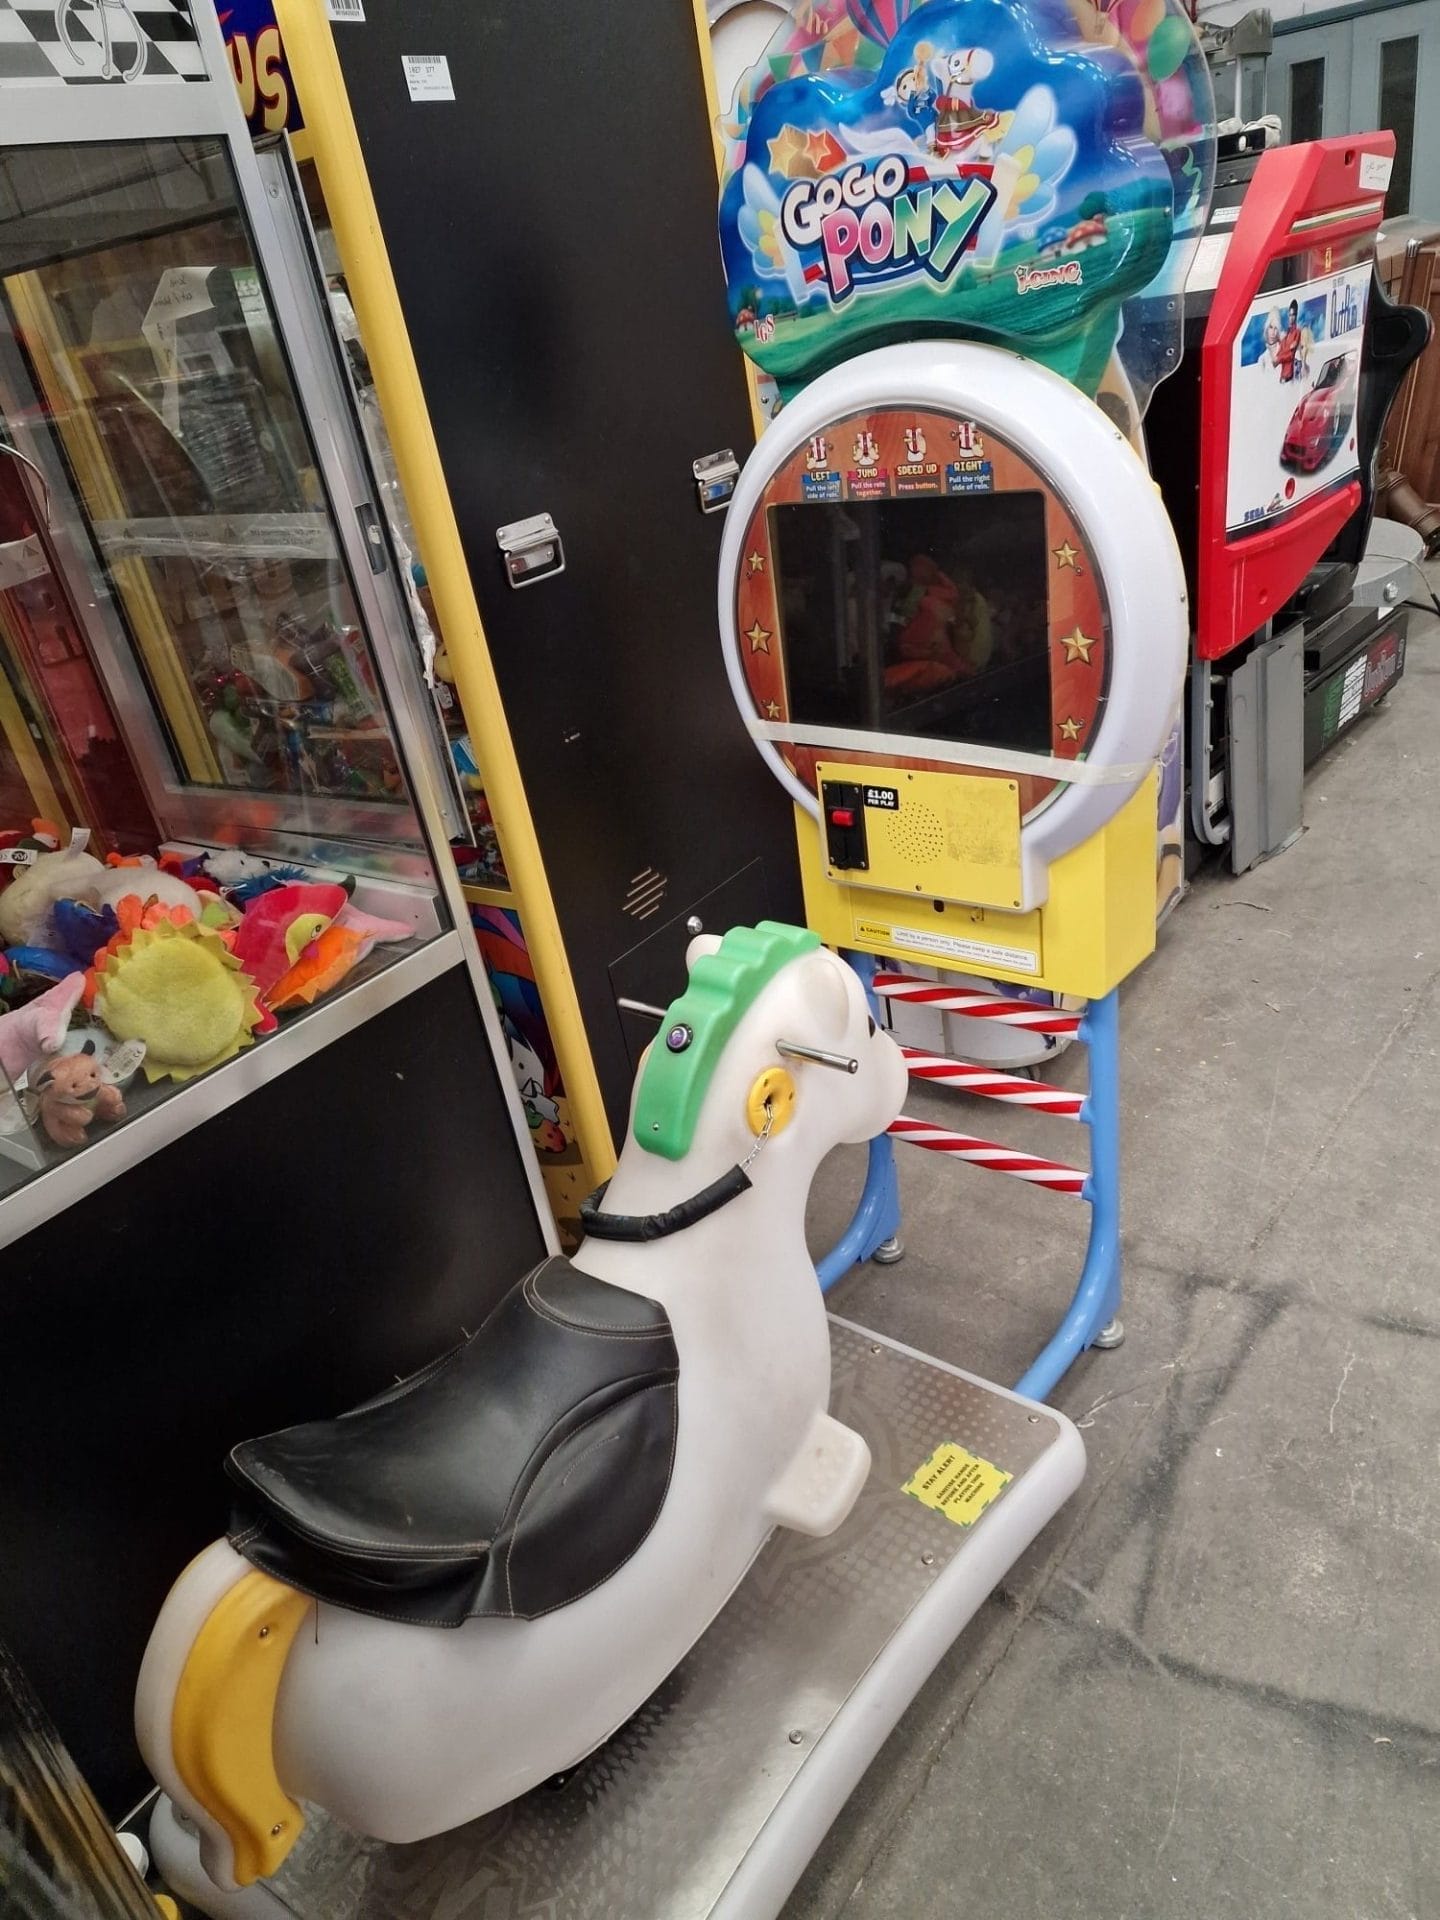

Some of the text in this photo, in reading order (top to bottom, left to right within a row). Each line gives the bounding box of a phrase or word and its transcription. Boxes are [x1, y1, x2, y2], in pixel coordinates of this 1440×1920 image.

[820, 175, 995, 298] PONY
[953, 460, 983, 472] RIGHT
[811, 471, 830, 482] LEFT
[974, 474, 991, 484] right
[851, 482, 862, 490] Pull
[1243, 506, 1265, 522] SEGA
[867, 789, 894, 801] £1.00
[880, 799, 894, 807] PLAY
[865, 926, 890, 936] CAUTION
[922, 1455, 955, 1490] STAY ALERT
[941, 1463, 980, 1506] BEFORE AND AFTER
